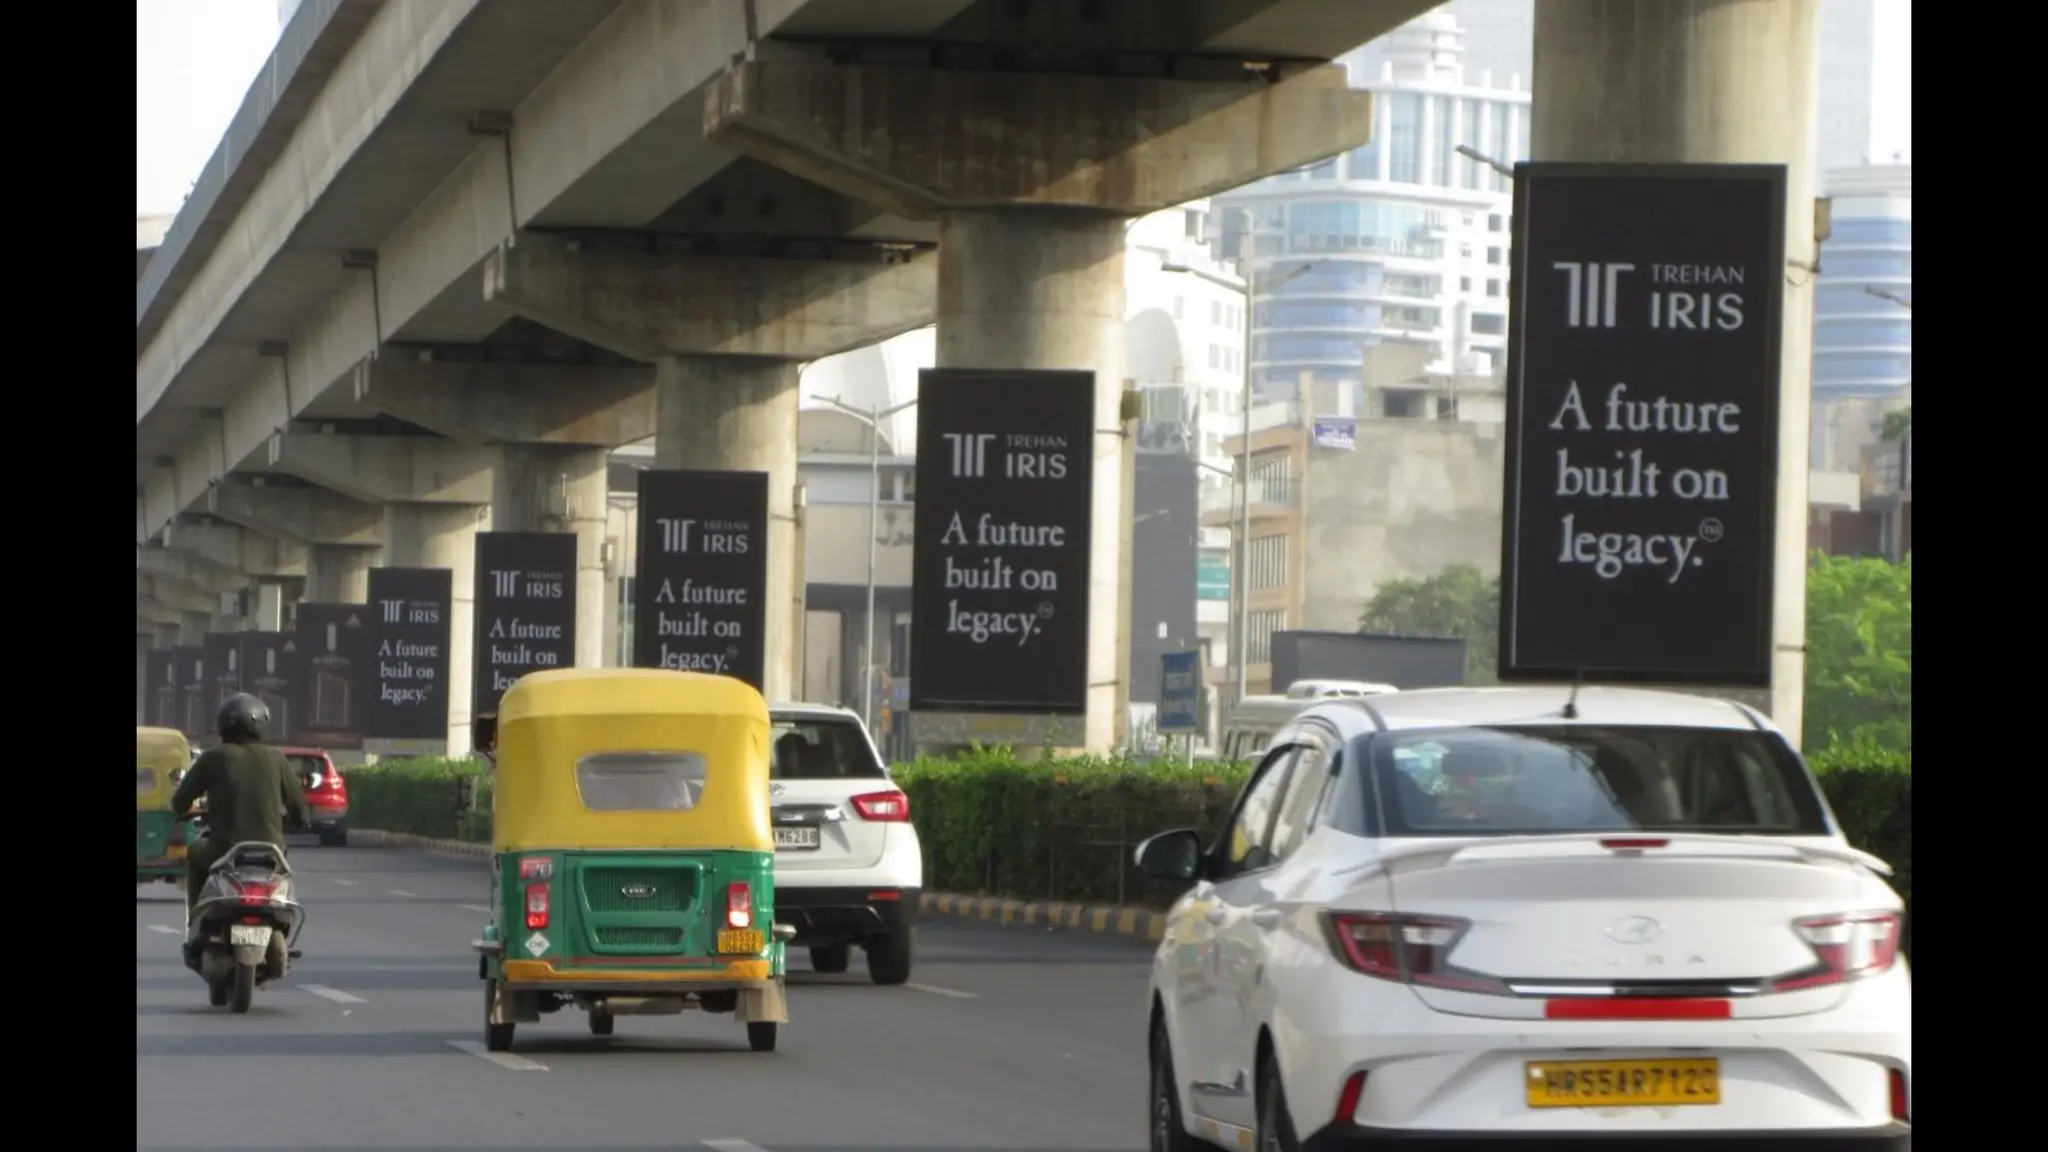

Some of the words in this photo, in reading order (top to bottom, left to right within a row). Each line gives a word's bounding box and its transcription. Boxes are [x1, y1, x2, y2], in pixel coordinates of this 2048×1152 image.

[1652, 264, 1744, 284] TREHAN
[1651, 292, 1743, 330] IRIS
[1549, 381, 1592, 430] A
[1606, 383, 1740, 433] future
[1007, 434, 1067, 448] TREHAN
[1007, 453, 1066, 478] IRIS
[1556, 448, 1661, 497] built
[1672, 469, 1729, 499] on
[941, 512, 968, 545] A
[978, 513, 1065, 546] future
[704, 534, 748, 553] IRIS
[1559, 514, 1704, 583] legacy.
[945, 557, 1013, 589] built
[1020, 569, 1057, 590] on
[527, 582, 562, 597] IRIS
[655, 578, 675, 603] A
[682, 579, 746, 604] future
[410, 610, 439, 623] IRIS
[489, 618, 505, 638] A
[510, 618, 561, 639] future
[658, 612, 708, 636] built
[714, 621, 741, 637] on
[947, 599, 1042, 645] legacy.
[378, 640, 392, 656] A
[396, 640, 437, 657] future
[492, 644, 531, 664] built
[535, 652, 557, 664] on
[380, 661, 412, 678] built
[416, 668, 434, 678] on
